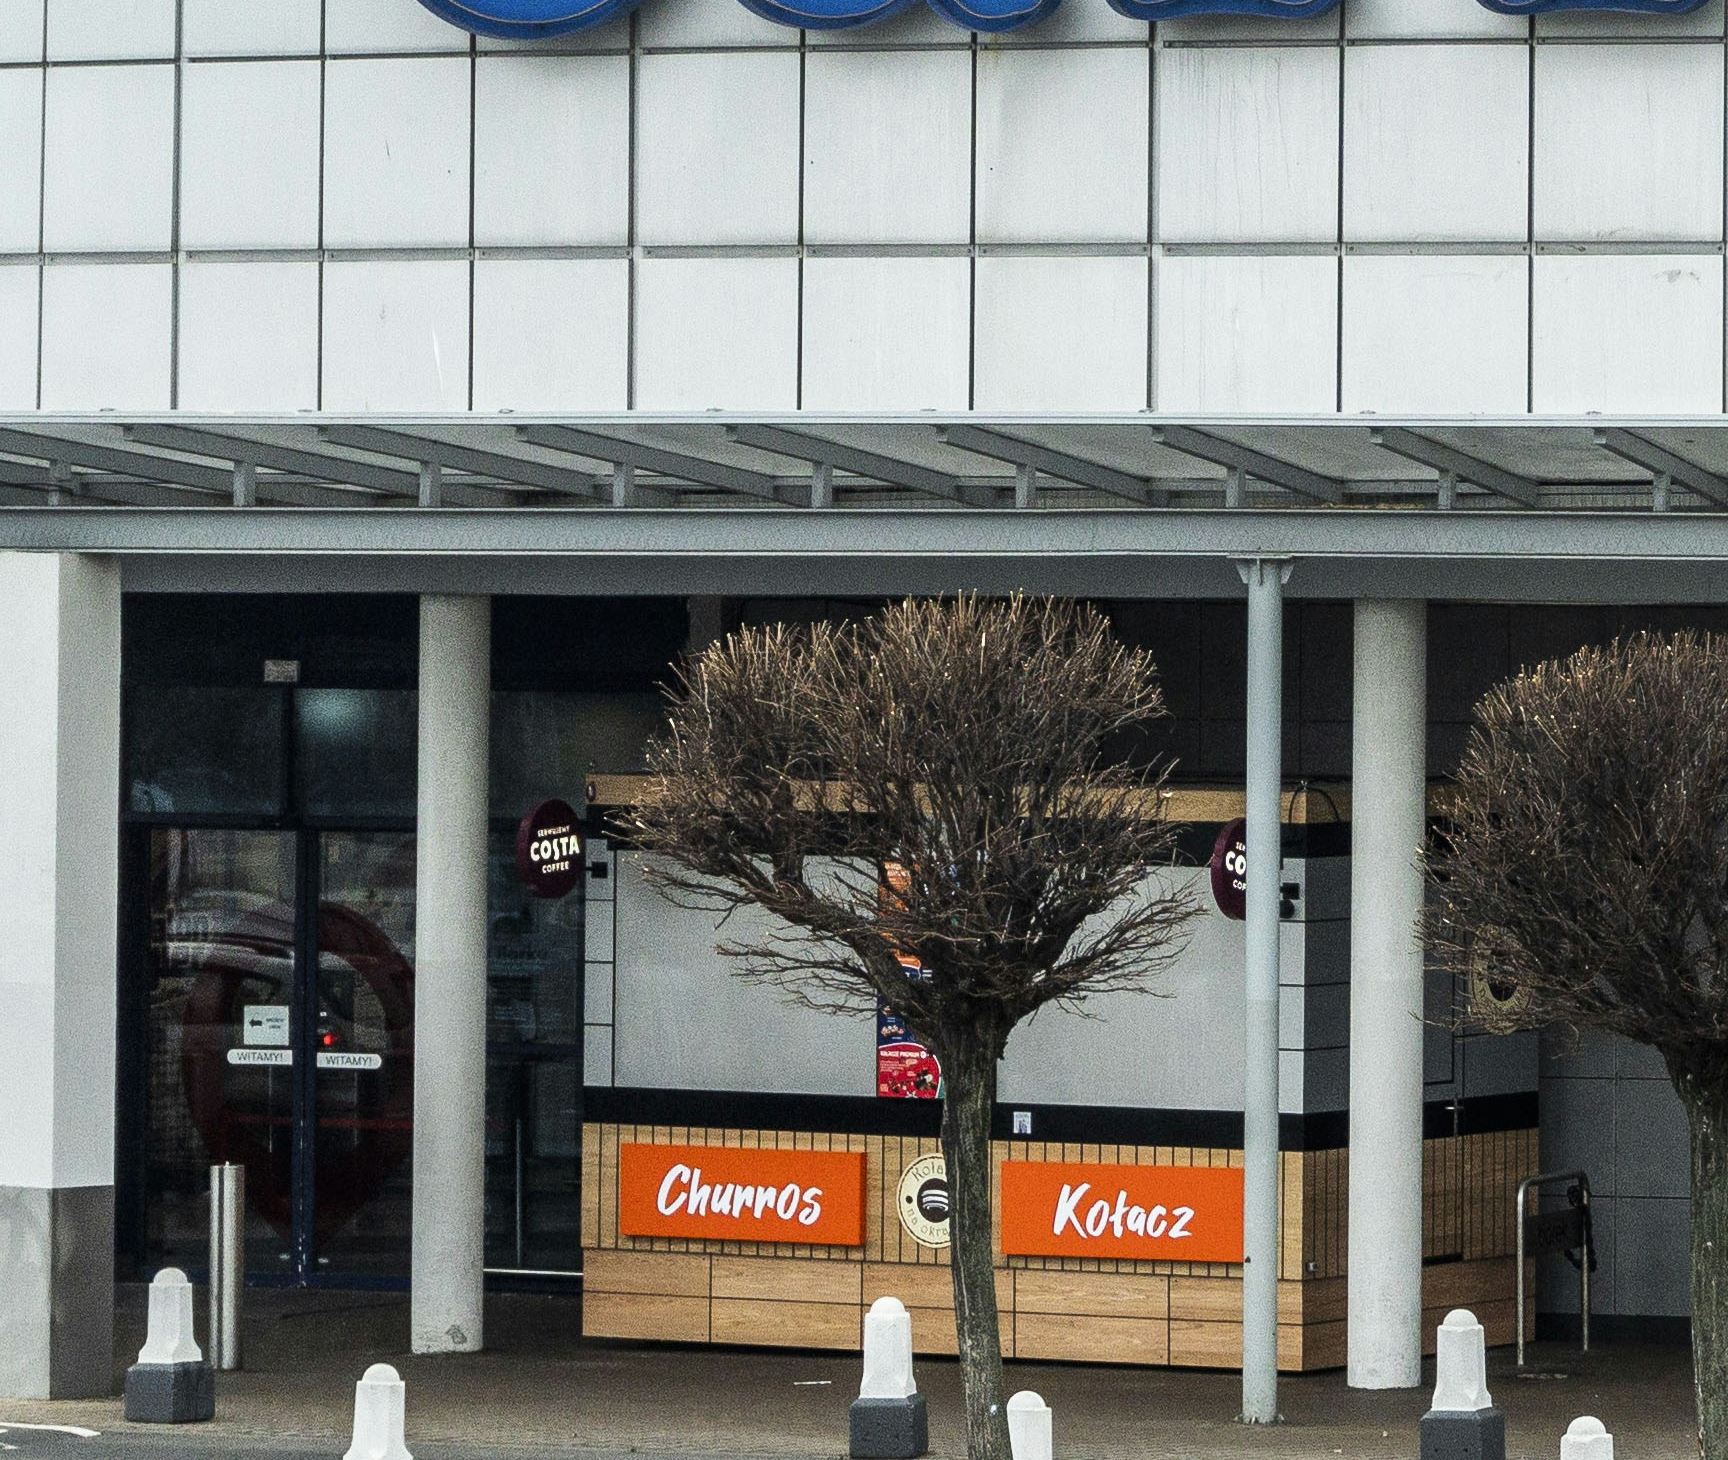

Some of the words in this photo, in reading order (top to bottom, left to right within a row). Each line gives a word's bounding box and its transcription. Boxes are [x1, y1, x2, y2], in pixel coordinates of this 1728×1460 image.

[530, 835, 580, 861] COSTA
[542, 861, 570, 874] COFFEE
[1225, 850, 1246, 875] CO
[1232, 879, 1246, 891] COF
[236, 1051, 283, 1061] WITAMY!
[325, 1055, 373, 1066] WITAMY!
[911, 1161, 944, 1182] Koła
[656, 1163, 823, 1226] Churros
[1053, 1183, 1194, 1239] Kołacz
